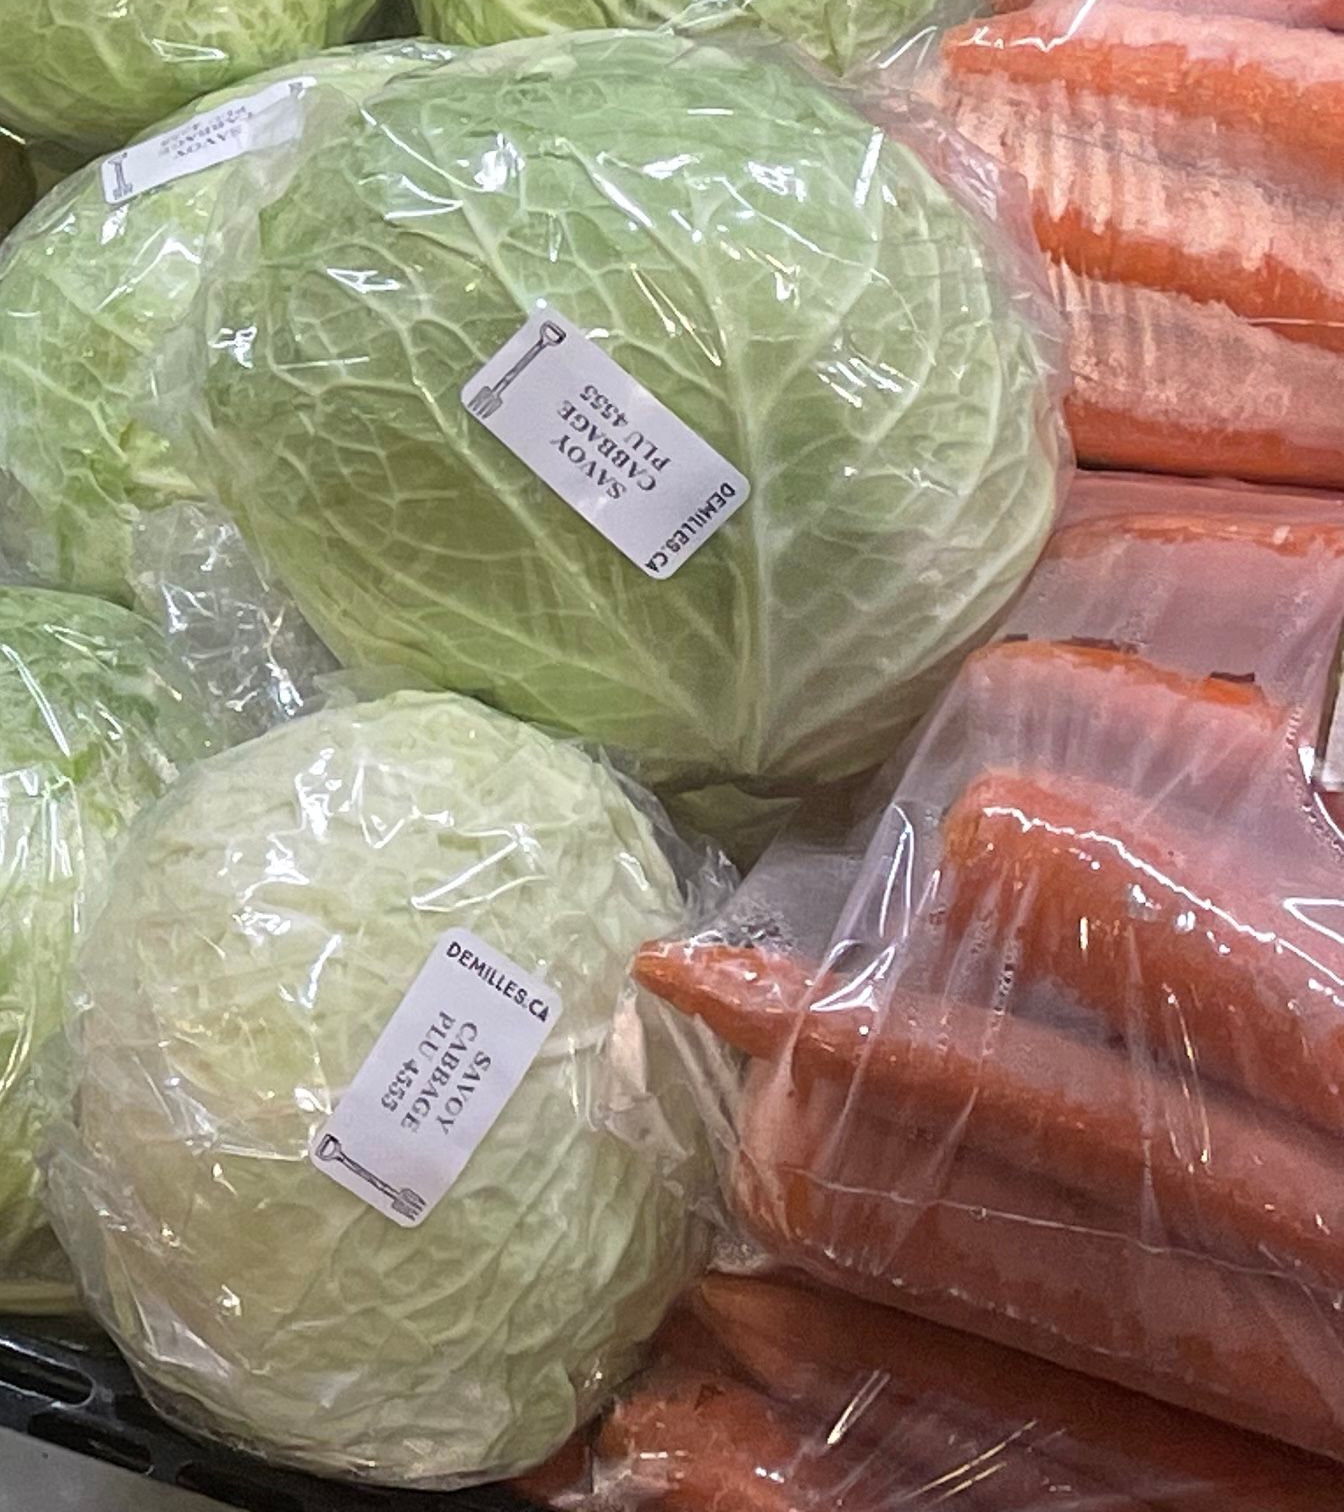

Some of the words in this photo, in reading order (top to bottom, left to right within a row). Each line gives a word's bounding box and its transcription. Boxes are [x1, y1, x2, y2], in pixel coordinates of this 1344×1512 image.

[579, 384, 629, 428] 4555
[550, 434, 628, 501] SAVOY
[556, 399, 658, 493] CABBAGE
[623, 431, 672, 473] PLU
[644, 481, 737, 573] DEMILLES.CA
[446, 941, 550, 1023] DEMILLES.CA
[418, 1010, 457, 1064] PLU
[380, 1058, 420, 1114] 4555
[400, 1021, 479, 1135] CABBAGE
[435, 1050, 492, 1136] SAVOY
